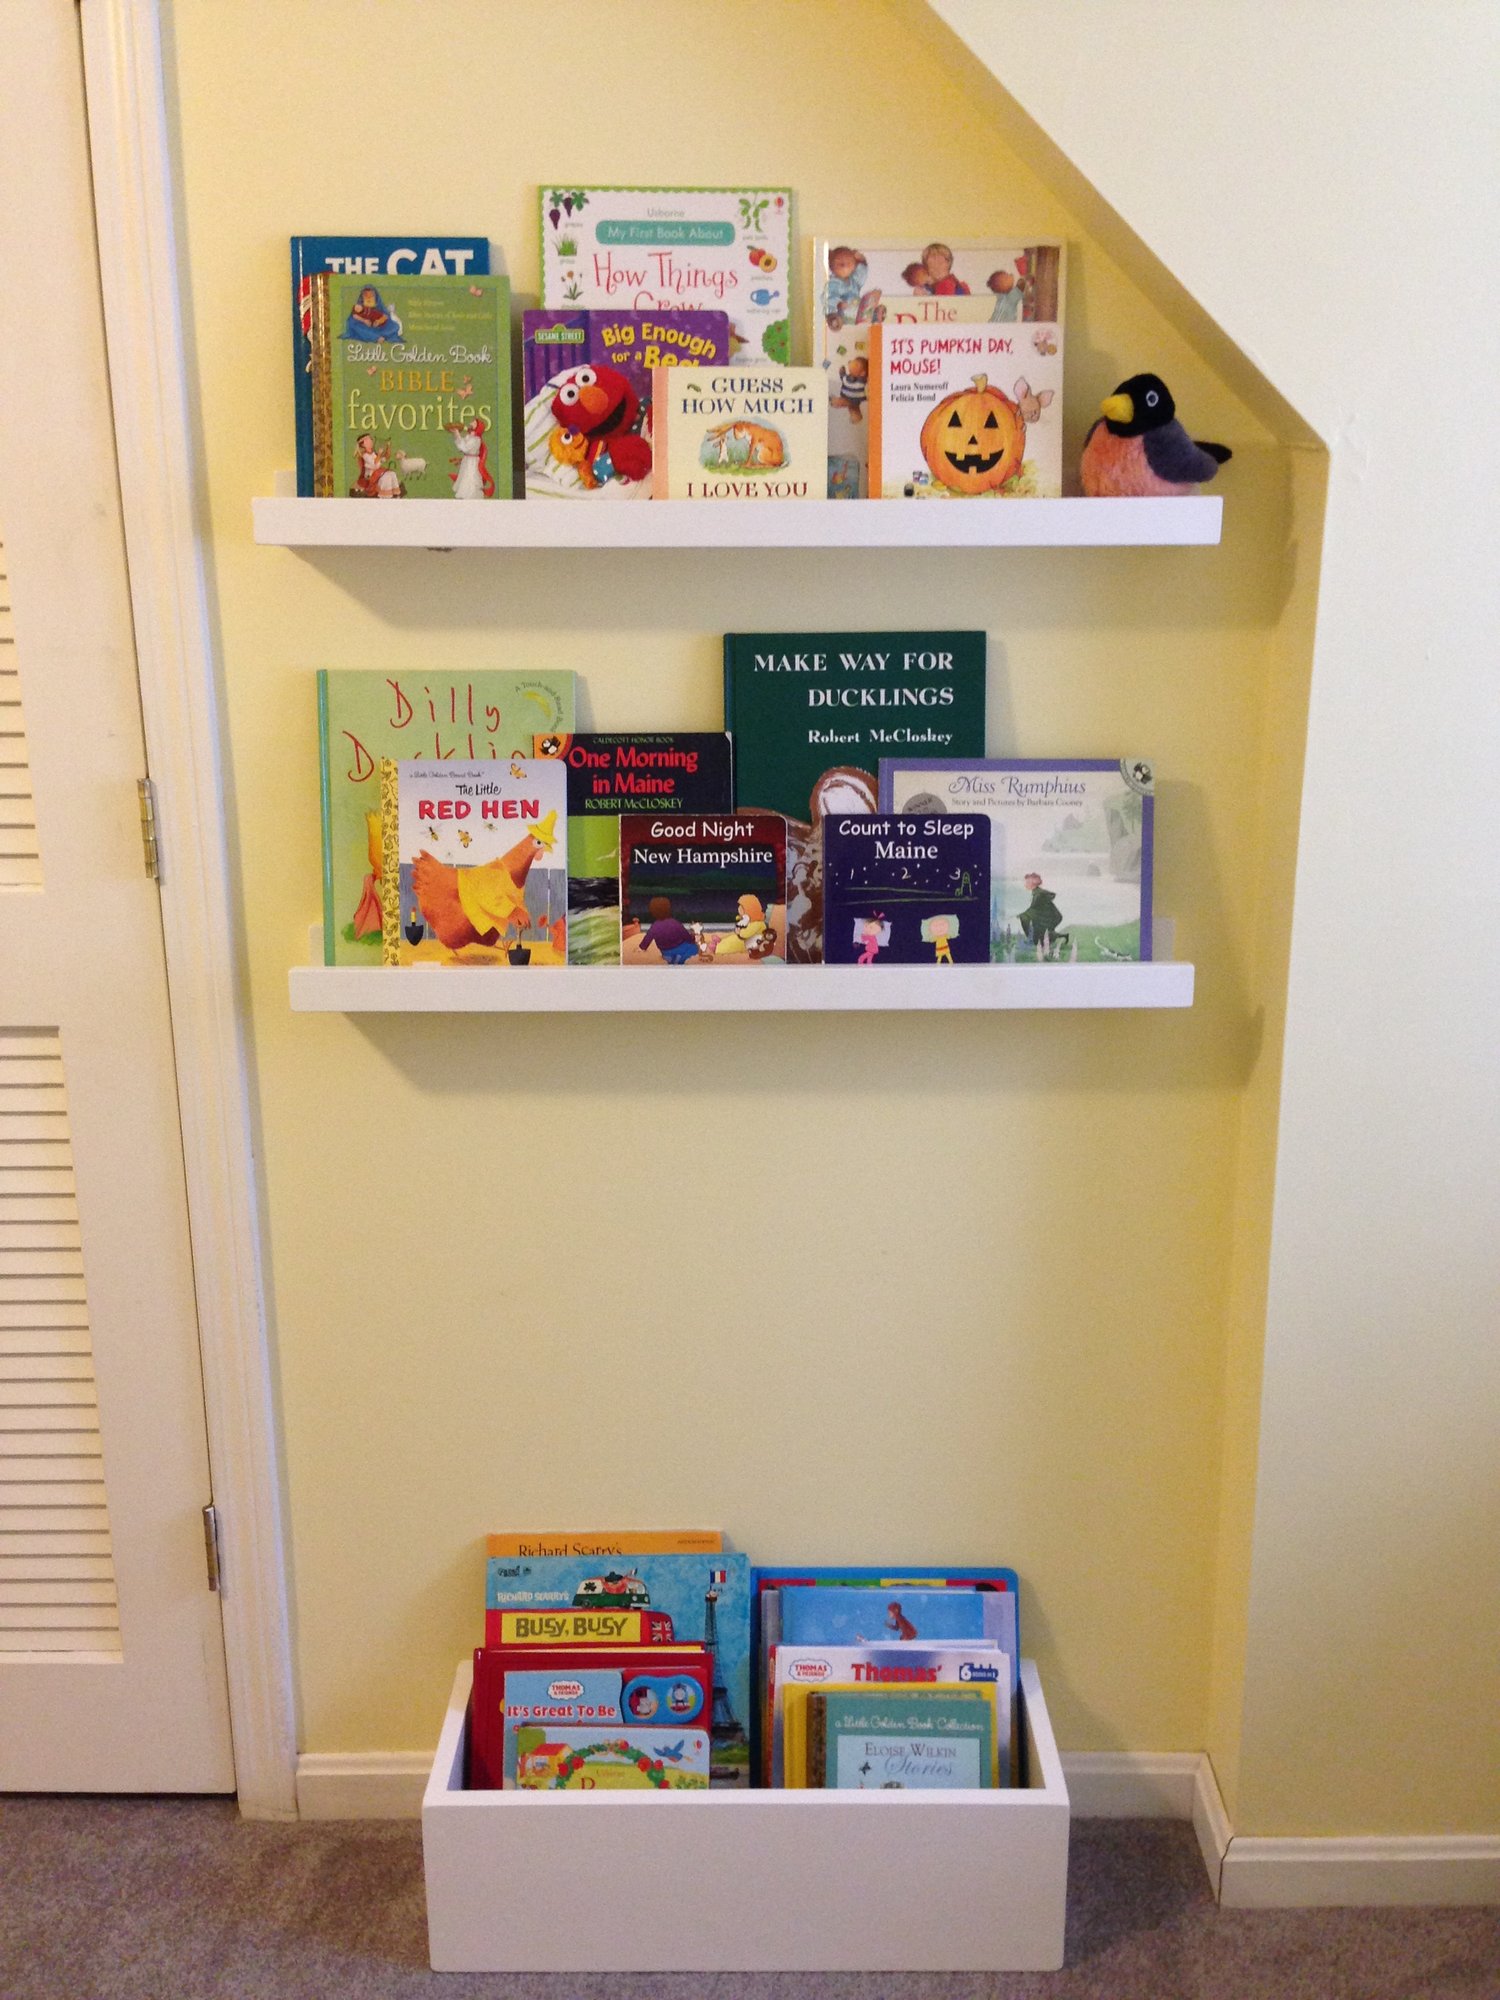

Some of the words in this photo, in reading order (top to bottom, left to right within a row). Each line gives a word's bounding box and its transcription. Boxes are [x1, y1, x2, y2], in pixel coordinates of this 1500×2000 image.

[646, 208, 686, 218] Usborne
[607, 226, 625, 240] My
[629, 226, 654, 239] First
[656, 226, 686, 239] Book
[689, 226, 724, 240] About
[324, 256, 380, 275] THE
[386, 248, 475, 276] CAT
[593, 251, 648, 296] How
[647, 251, 739, 299] Things
[918, 301, 958, 322] The
[537, 331, 560, 341] SESAME
[561, 331, 583, 341] STREET
[602, 323, 635, 348] Big
[641, 322, 717, 360] Enough
[346, 343, 389, 363] Little
[390, 342, 448, 364] Golden
[449, 343, 493, 364] Book
[890, 338, 914, 355] IT'S
[920, 338, 983, 355] PUMPKIN
[611, 350, 631, 364] for
[634, 351, 642, 361] a
[890, 358, 942, 376] MOUSE!
[379, 368, 456, 394] BIBLE
[711, 377, 785, 394] GUESS
[890, 382, 912, 391] Laura
[914, 381, 949, 391] Numeroff
[681, 398, 736, 415] HOW
[743, 398, 814, 415] MUCH
[890, 393, 915, 403] Felicia
[917, 393, 937, 402] Bond
[348, 388, 493, 432] favorites
[687, 481, 694, 498] I
[702, 481, 759, 498] LOVE
[762, 481, 809, 498] YOU
[753, 653, 828, 672] MAKE
[838, 652, 891, 671] WAY
[902, 652, 954, 671] FOR
[386, 678, 501, 733] Dilly
[807, 686, 955, 707] DUCKLINGS
[807, 728, 861, 744] Robert
[868, 727, 954, 746] McCloskey
[568, 745, 612, 769] One
[615, 746, 698, 773] Morning
[455, 783, 474, 796] The
[475, 781, 502, 796] Little
[592, 773, 611, 794] in
[614, 772, 676, 794] Maine
[948, 775, 996, 794] Miss
[1000, 775, 1087, 798] Rumphius
[418, 800, 472, 821] RED
[481, 799, 540, 820] HEN
[585, 797, 623, 810] ROBERT
[624, 797, 684, 810] McCLOSKEY
[972, 798, 986, 806] and
[650, 821, 697, 838] Good
[702, 820, 755, 842] Night
[838, 818, 891, 836] Count
[897, 820, 917, 836] to
[922, 819, 975, 840] Sleep
[633, 848, 672, 864] New
[676, 847, 773, 869] Hampshire
[874, 840, 939, 860] Maine
[901, 867, 912, 880] 2
[949, 866, 961, 880] 3
[518, 1542, 568, 1557] Richard
[515, 1616, 570, 1638] BUSY,
[573, 1616, 629, 1637] BUSY
[795, 1664, 828, 1672] THOMAS
[850, 1661, 943, 1683] Thomas'
[960, 1664, 972, 1681] 6
[551, 1684, 581, 1692] THOMAS
[507, 1704, 530, 1717] It's
[532, 1704, 574, 1717] Great
[576, 1704, 595, 1716] To
[597, 1704, 616, 1717] Be
[834, 1720, 842, 1729] a
[843, 1715, 869, 1729] Little
[869, 1715, 906, 1730] Golden
[906, 1716, 934, 1731] Book
[935, 1716, 985, 1732] Collection
[883, 1755, 953, 1778] Stories
